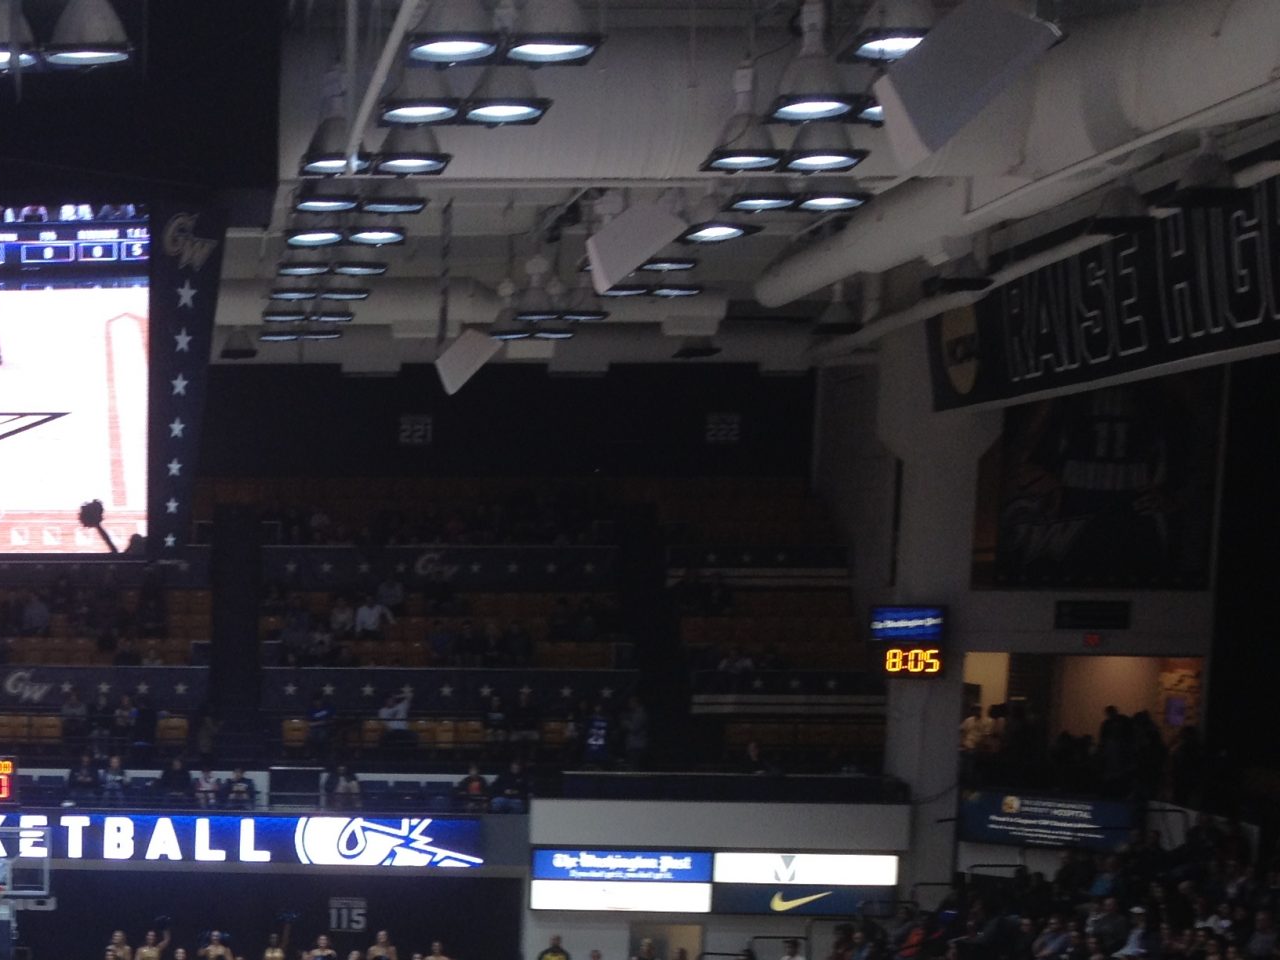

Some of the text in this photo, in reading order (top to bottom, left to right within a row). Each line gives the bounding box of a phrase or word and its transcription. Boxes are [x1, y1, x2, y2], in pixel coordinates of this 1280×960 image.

[1003, 233, 1149, 382] RAISE
[885, 648, 940, 673] 8:05
[4, 668, 53, 703] GW
[579, 852, 658, 872] Washington
[659, 856, 692, 873] Post
[329, 908, 368, 930] 115
